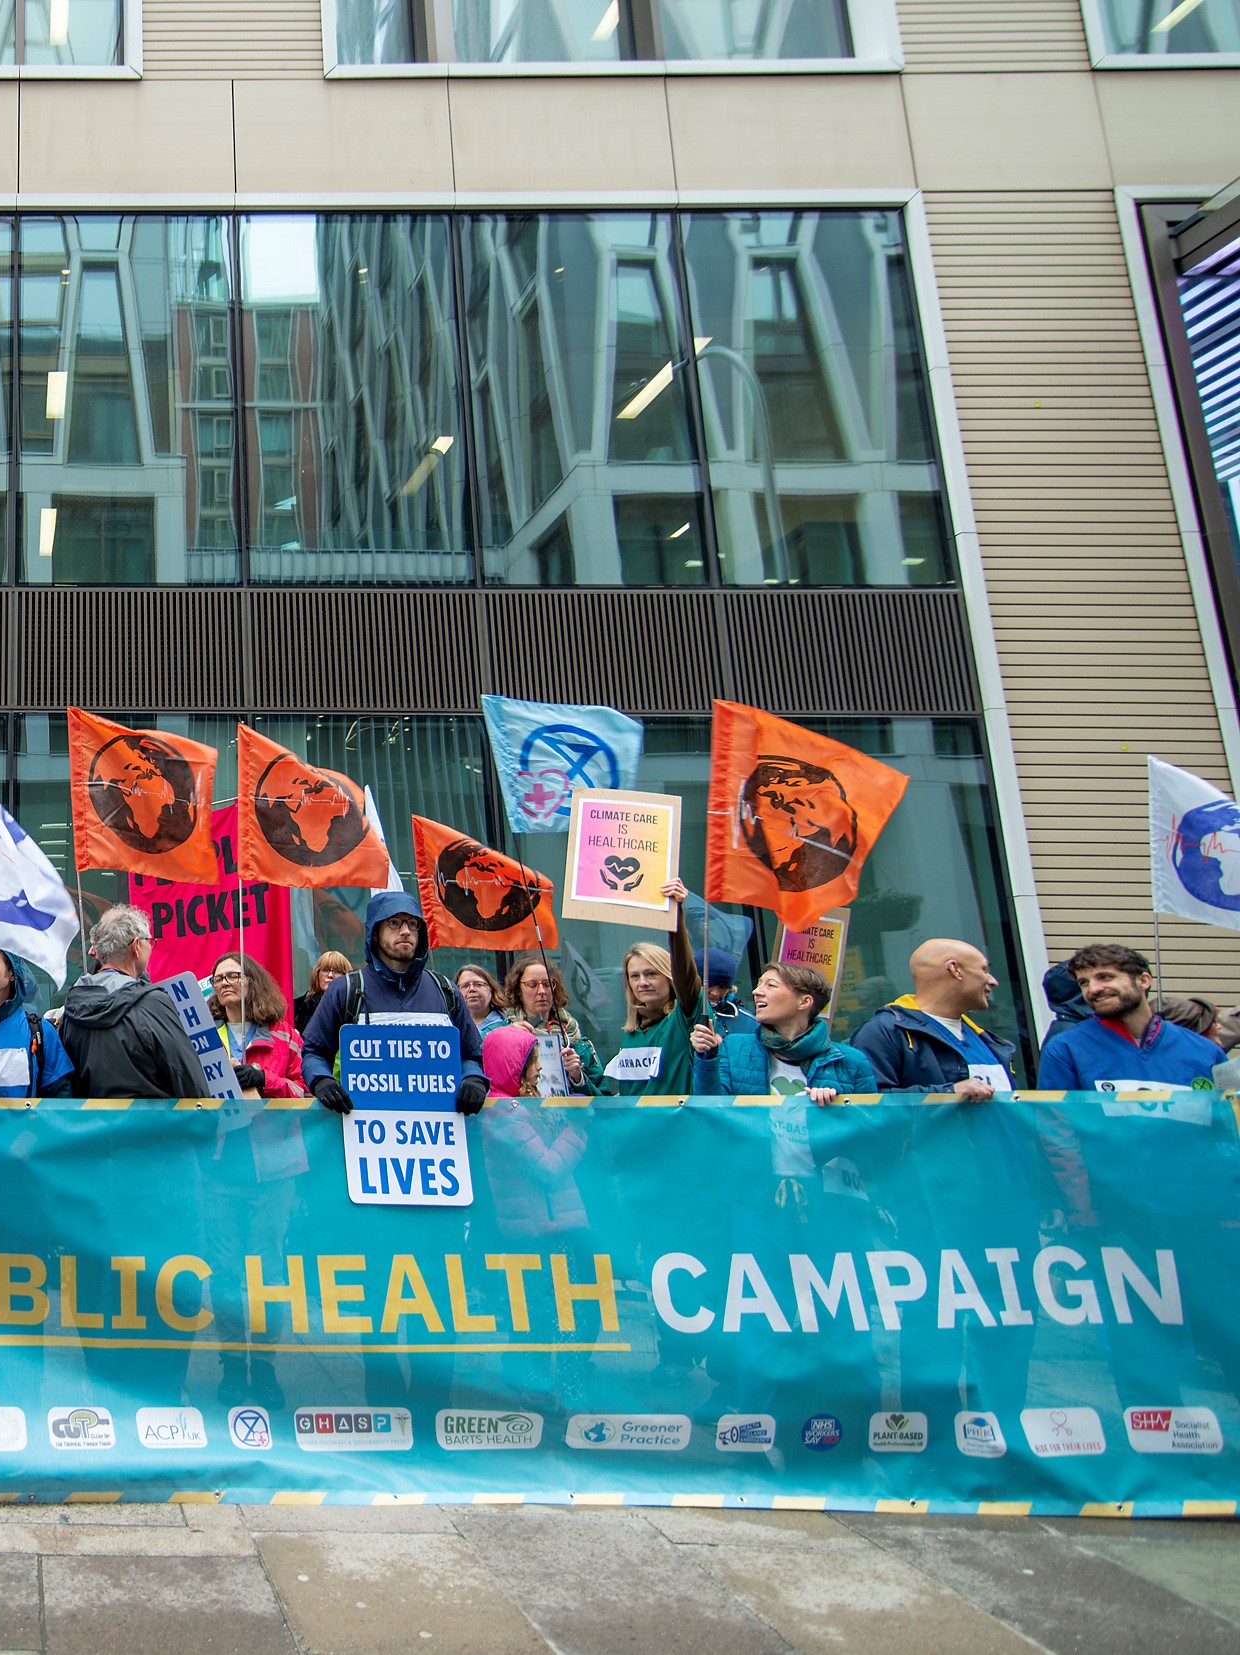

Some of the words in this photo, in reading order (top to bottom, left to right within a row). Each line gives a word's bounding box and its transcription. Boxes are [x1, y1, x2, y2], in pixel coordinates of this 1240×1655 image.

[590, 810, 631, 822] CLIMATE
[633, 814, 658, 825] CARE
[618, 824, 628, 834] IS
[588, 836, 659, 852] HEALTHCARE
[151, 883, 269, 938] PICKET
[819, 928, 835, 939] CARE
[808, 939, 815, 949] IS
[787, 949, 833, 966] HEALTHCARE
[350, 1039, 382, 1058] CUT
[387, 1040, 423, 1059] TIES
[428, 1040, 451, 1059] TO
[347, 1073, 403, 1092] FOSSIL
[407, 1074, 456, 1093] FUELS
[354, 1119, 385, 1145] TO
[396, 1120, 456, 1146] SAVE
[358, 1157, 460, 1197] LIVES
[244, 1253, 621, 1334] HEALTH
[650, 1246, 1184, 1334] CAMPAIGN
[444, 1415, 499, 1434] GREEN
[622, 1421, 683, 1433] Greener
[813, 1420, 833, 1429] NHS
[1174, 1420, 1210, 1429] Socialist
[145, 1425, 179, 1440] ACP
[873, 1432, 924, 1440] PLANT-BASED
[1172, 1430, 1200, 1439] Health
[445, 1434, 483, 1444] BARTS
[487, 1434, 532, 1444] HEALTH
[620, 1434, 681, 1445] Practice
[804, 1436, 821, 1444] SAY
[1035, 1443, 1048, 1452] RIDE
[1049, 1443, 1061, 1451] FOR
[1062, 1442, 1081, 1451] THEIR
[1083, 1441, 1101, 1451] LIVES
[1171, 1441, 1218, 1449] Association
